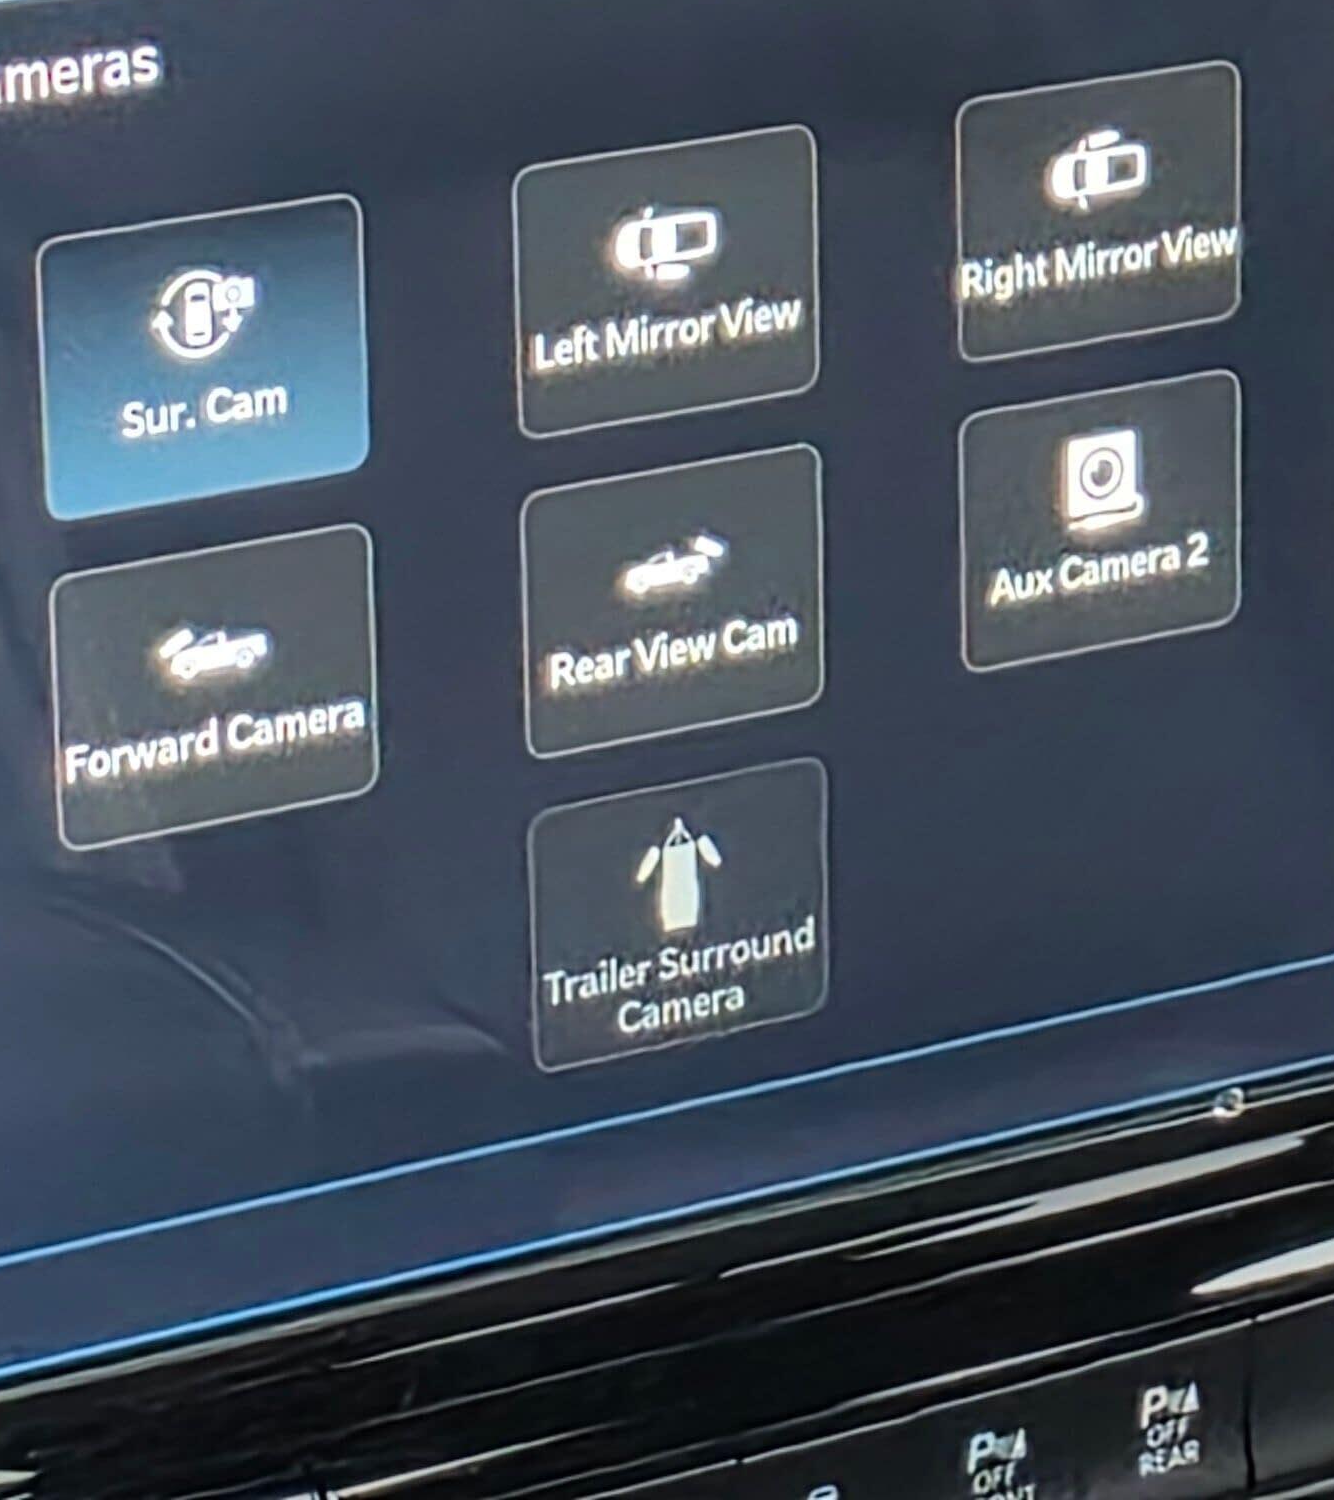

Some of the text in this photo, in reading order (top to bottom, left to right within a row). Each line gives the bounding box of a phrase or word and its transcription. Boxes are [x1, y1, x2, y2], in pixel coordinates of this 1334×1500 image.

[960, 225, 1240, 301] Right Mirror View
[533, 297, 802, 371] Left Mirror View
[121, 385, 288, 439] Sur. Cam
[988, 531, 1211, 607] Aux Camera 2
[549, 616, 799, 691] Rear View Cam
[65, 699, 366, 785] Forward Camera
[543, 913, 816, 1007] Trailer Surround
[618, 984, 746, 1034] Camera
[1137, 1438, 1201, 1478] REAR
[1147, 1415, 1189, 1449] OFF
[972, 1459, 1016, 1496] OFF
